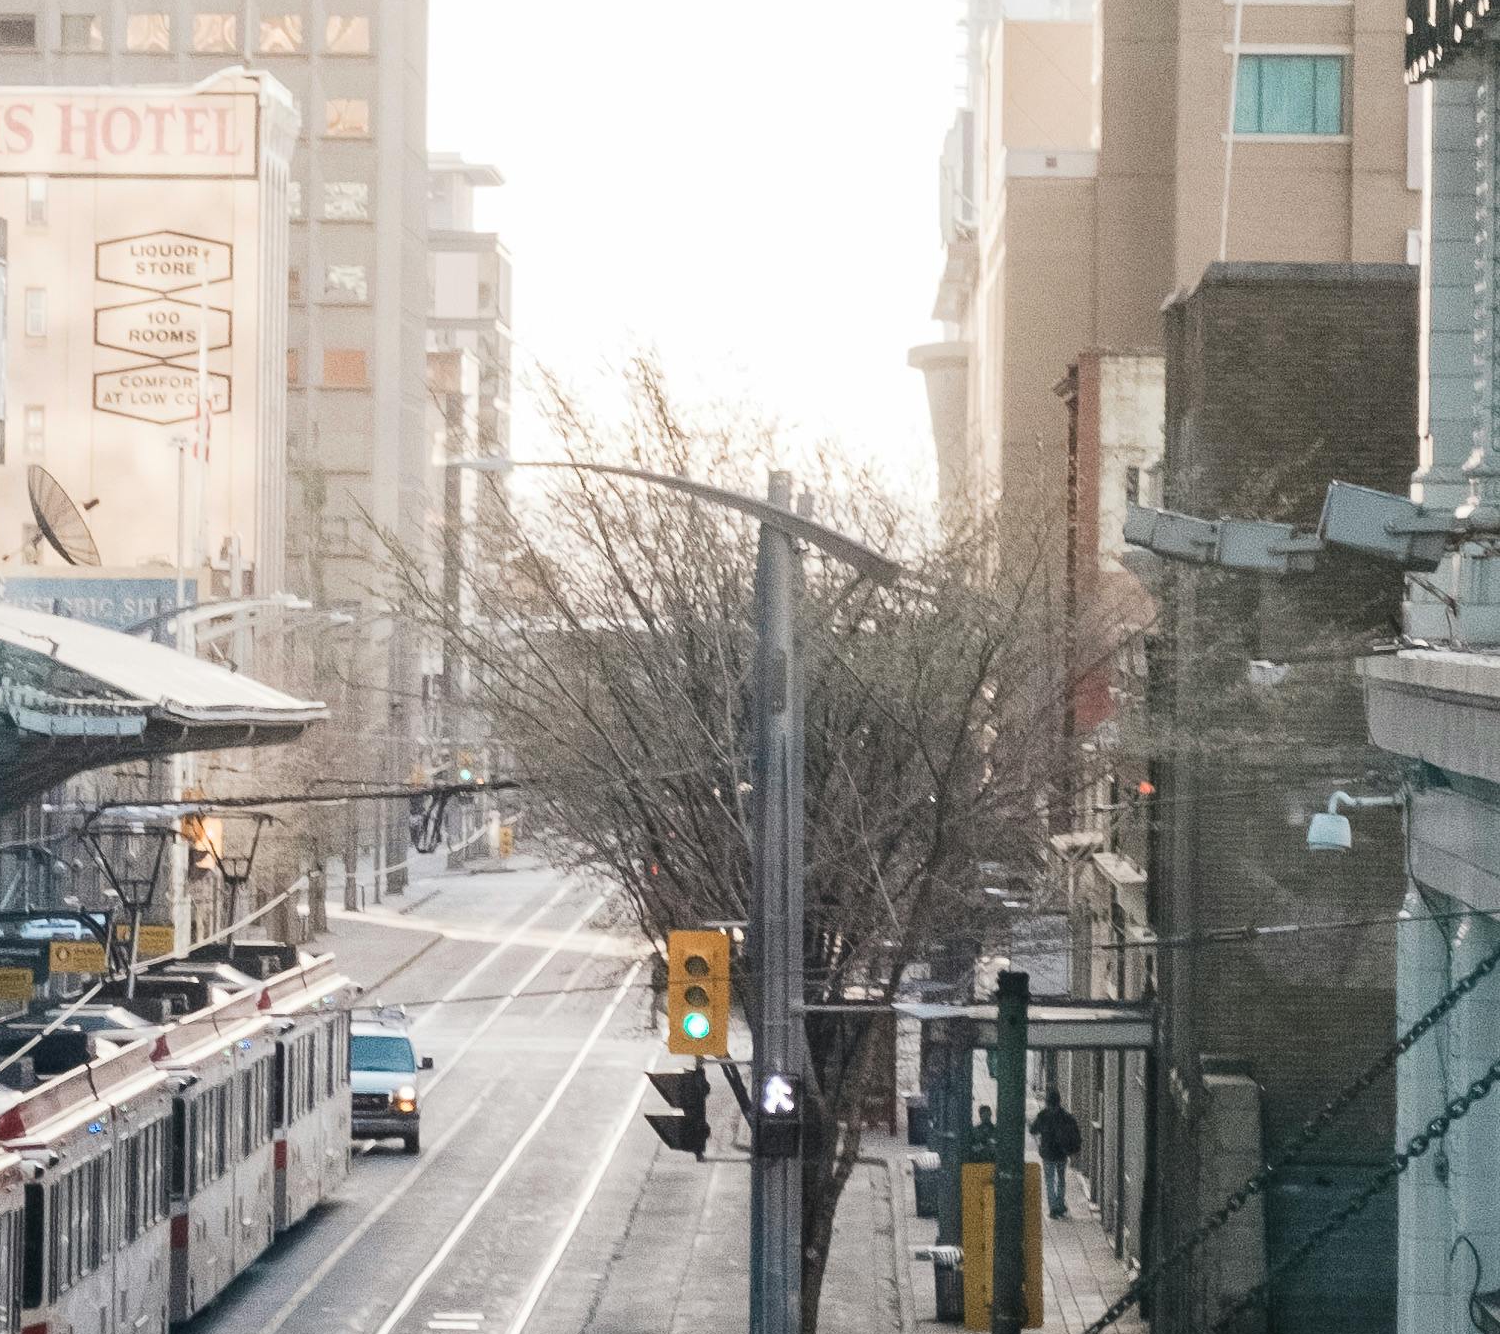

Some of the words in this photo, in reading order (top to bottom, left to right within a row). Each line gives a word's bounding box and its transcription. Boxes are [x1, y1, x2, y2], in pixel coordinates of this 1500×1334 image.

[57, 104, 244, 160] HOTEL
[129, 244, 199, 258] LIQUOR
[135, 262, 197, 275] STORE
[147, 311, 181, 325] 100
[128, 329, 198, 343] ROOMS
[102, 392, 124, 404] AT
[130, 392, 168, 405] LOW
[175, 392, 222, 406] COT
